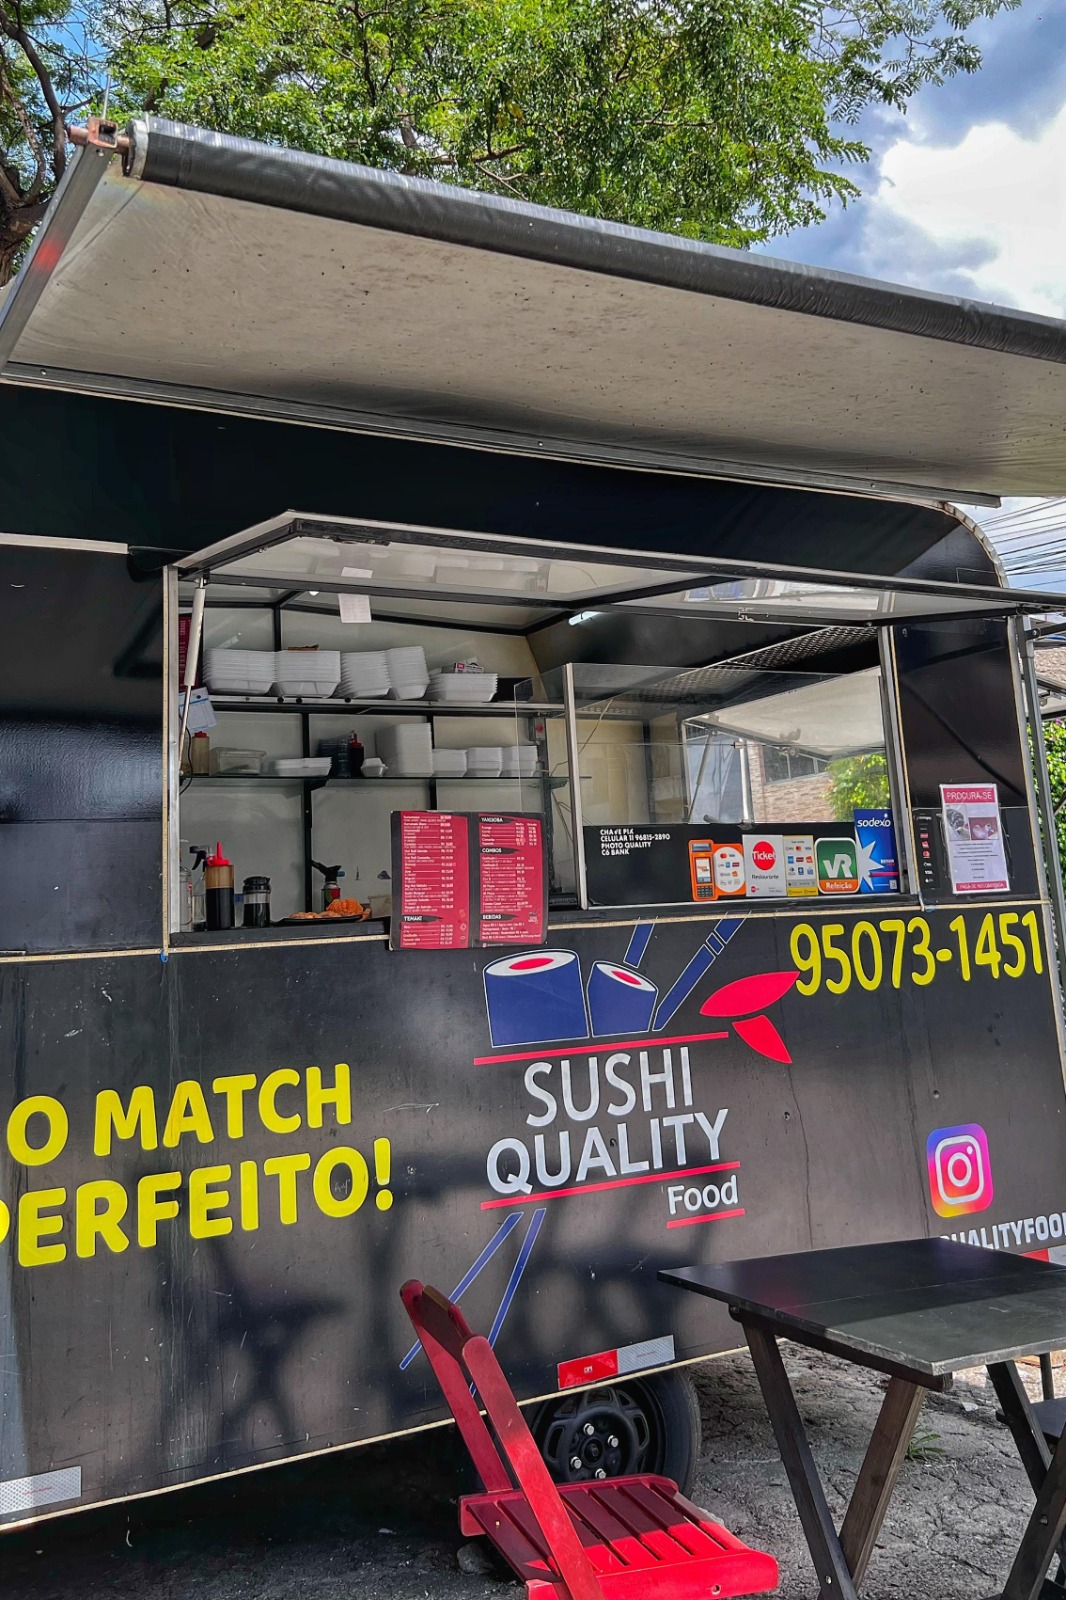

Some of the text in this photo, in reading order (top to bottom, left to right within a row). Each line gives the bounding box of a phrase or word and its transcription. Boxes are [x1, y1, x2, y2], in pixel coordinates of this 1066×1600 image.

[946, 791, 993, 800] PROCURA-SE
[857, 817, 891, 828] sodexo
[624, 841, 652, 849] QUALITY
[752, 850, 777, 861] Ticket
[825, 881, 853, 891] Refeição
[789, 910, 1044, 996] 95073-1451
[523, 1046, 694, 1128] SUSHI
[7, 1063, 352, 1166] O MATCH
[486, 1108, 729, 1195] QUALITY
[667, 1174, 739, 1215] Food
